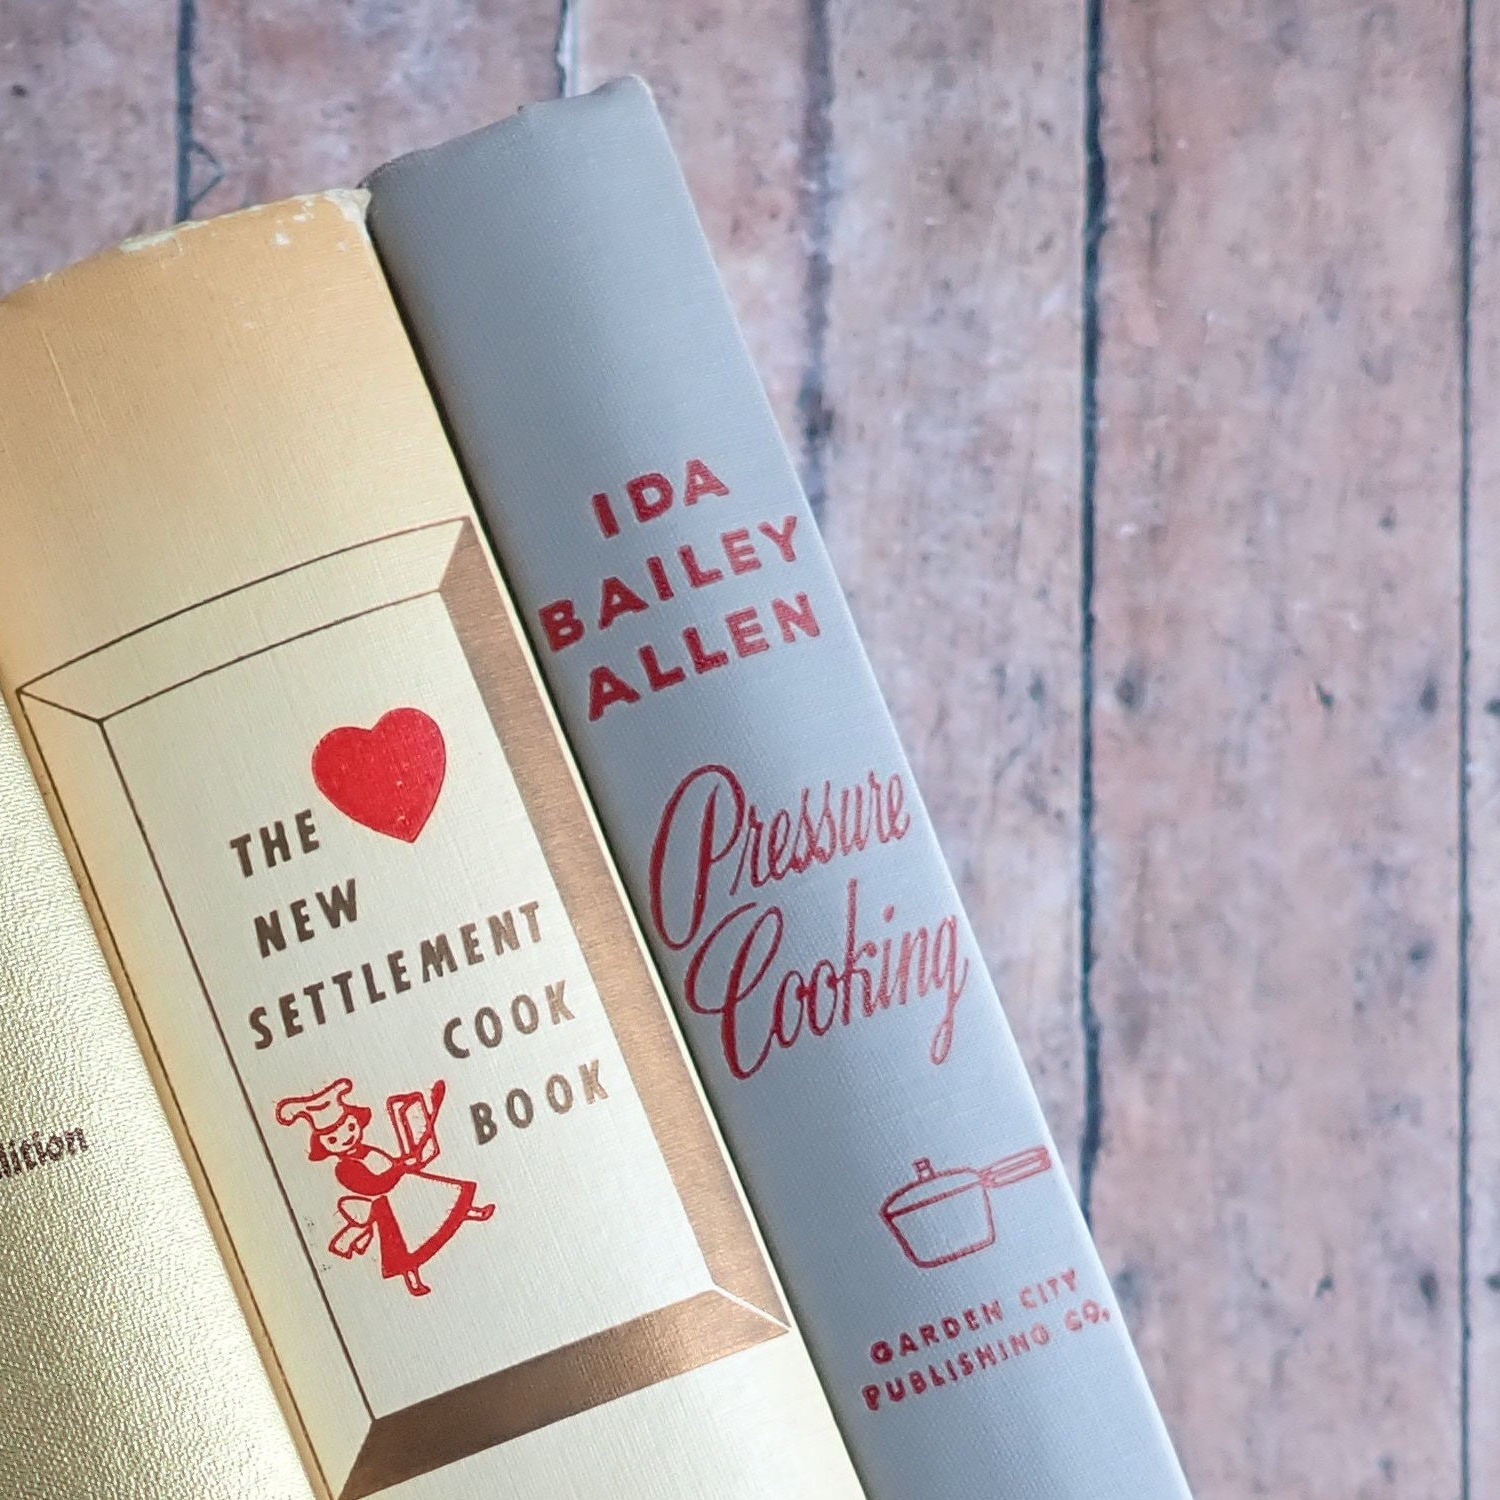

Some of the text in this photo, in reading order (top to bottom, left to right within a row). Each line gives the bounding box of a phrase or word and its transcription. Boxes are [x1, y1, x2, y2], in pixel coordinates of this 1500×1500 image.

[591, 458, 729, 539] IDA
[538, 515, 798, 651] BAILEY
[588, 591, 820, 722] ALLEN
[230, 809, 320, 878] THE
[649, 763, 910, 951] Pressure
[254, 878, 358, 958] NEW
[248, 900, 541, 1051] SETTLEMENT
[443, 979, 575, 1059] COOK
[684, 878, 969, 1080] Cooking
[469, 1059, 609, 1145] BOOK
[862, 1299, 1110, 1411] PUBLISHING CO.
[870, 1267, 1077, 1364] GARDEN CITY
